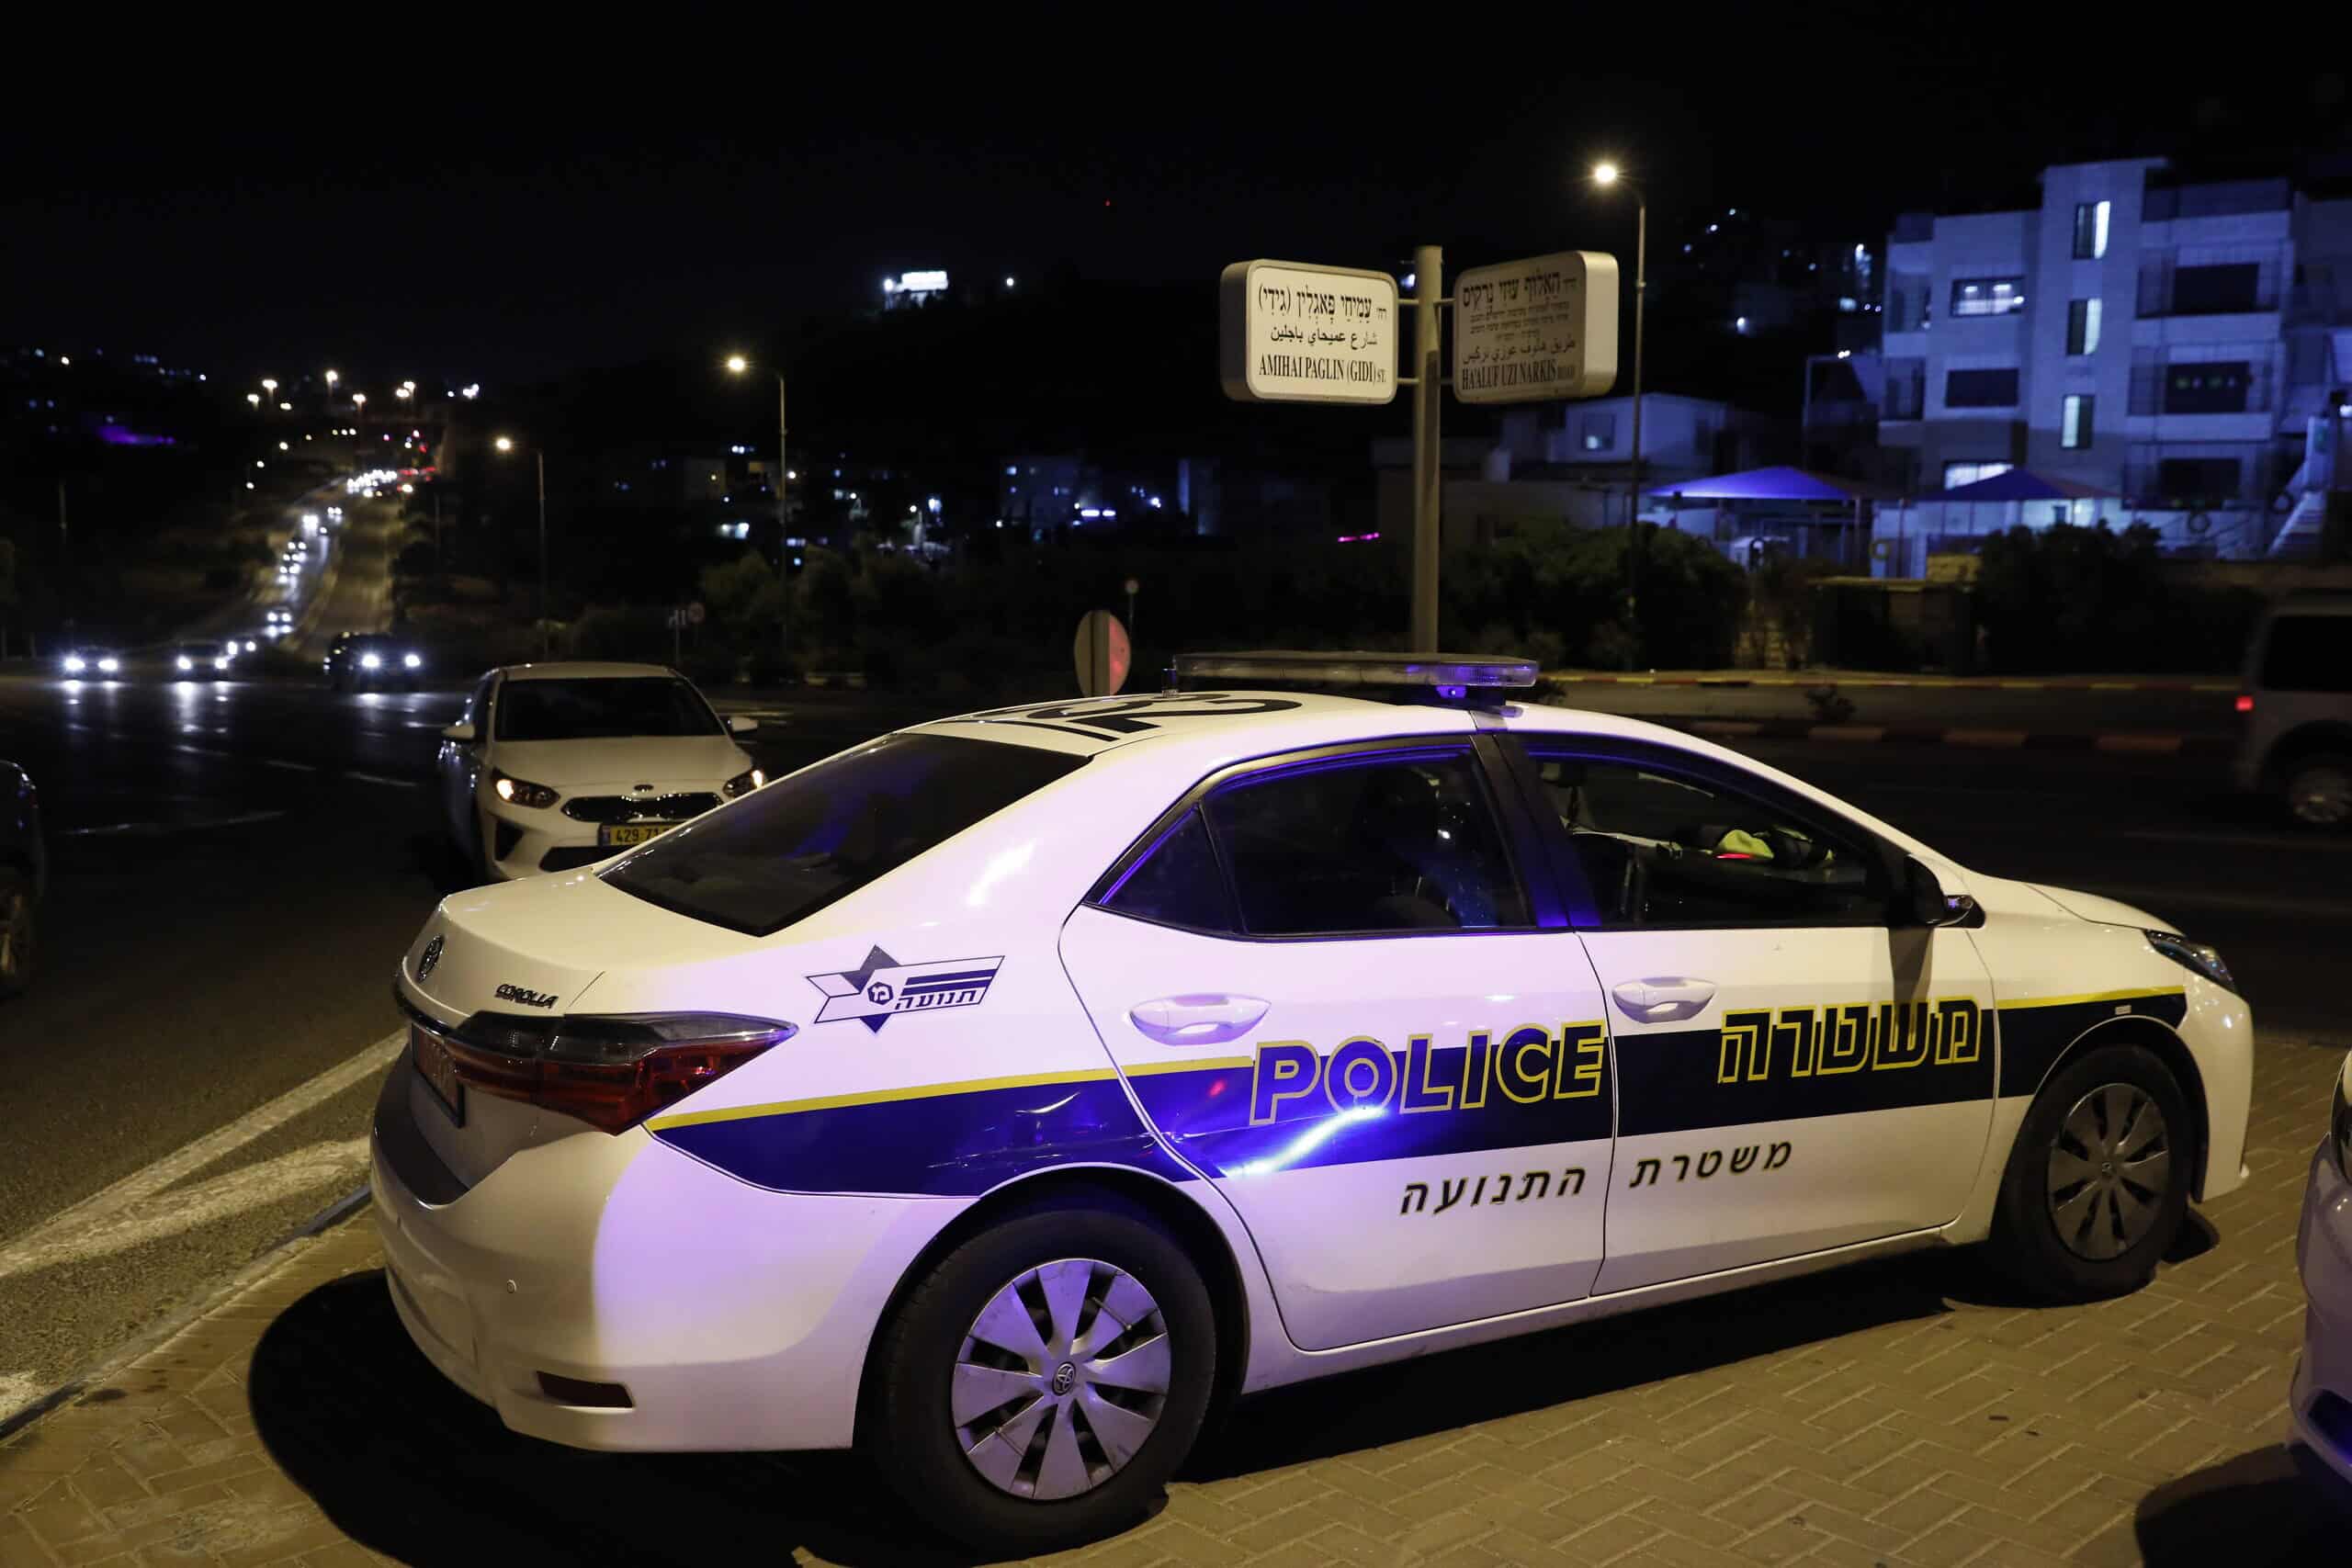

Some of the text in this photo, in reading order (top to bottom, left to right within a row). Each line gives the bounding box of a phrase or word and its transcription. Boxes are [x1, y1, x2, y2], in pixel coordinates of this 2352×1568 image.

[1259, 353, 1303, 378] AMIHAI
[1306, 356, 1344, 380] PAGLIN
[1347, 359, 1376, 384] (GIDI)
[494, 984, 559, 1009] COROLLA
[895, 989, 977, 1010] תנועה
[1716, 995, 1984, 1084] משטרה
[1250, 1019, 1607, 1127] POLICE
[1399, 1136, 1793, 1216] משטרת התנועה
